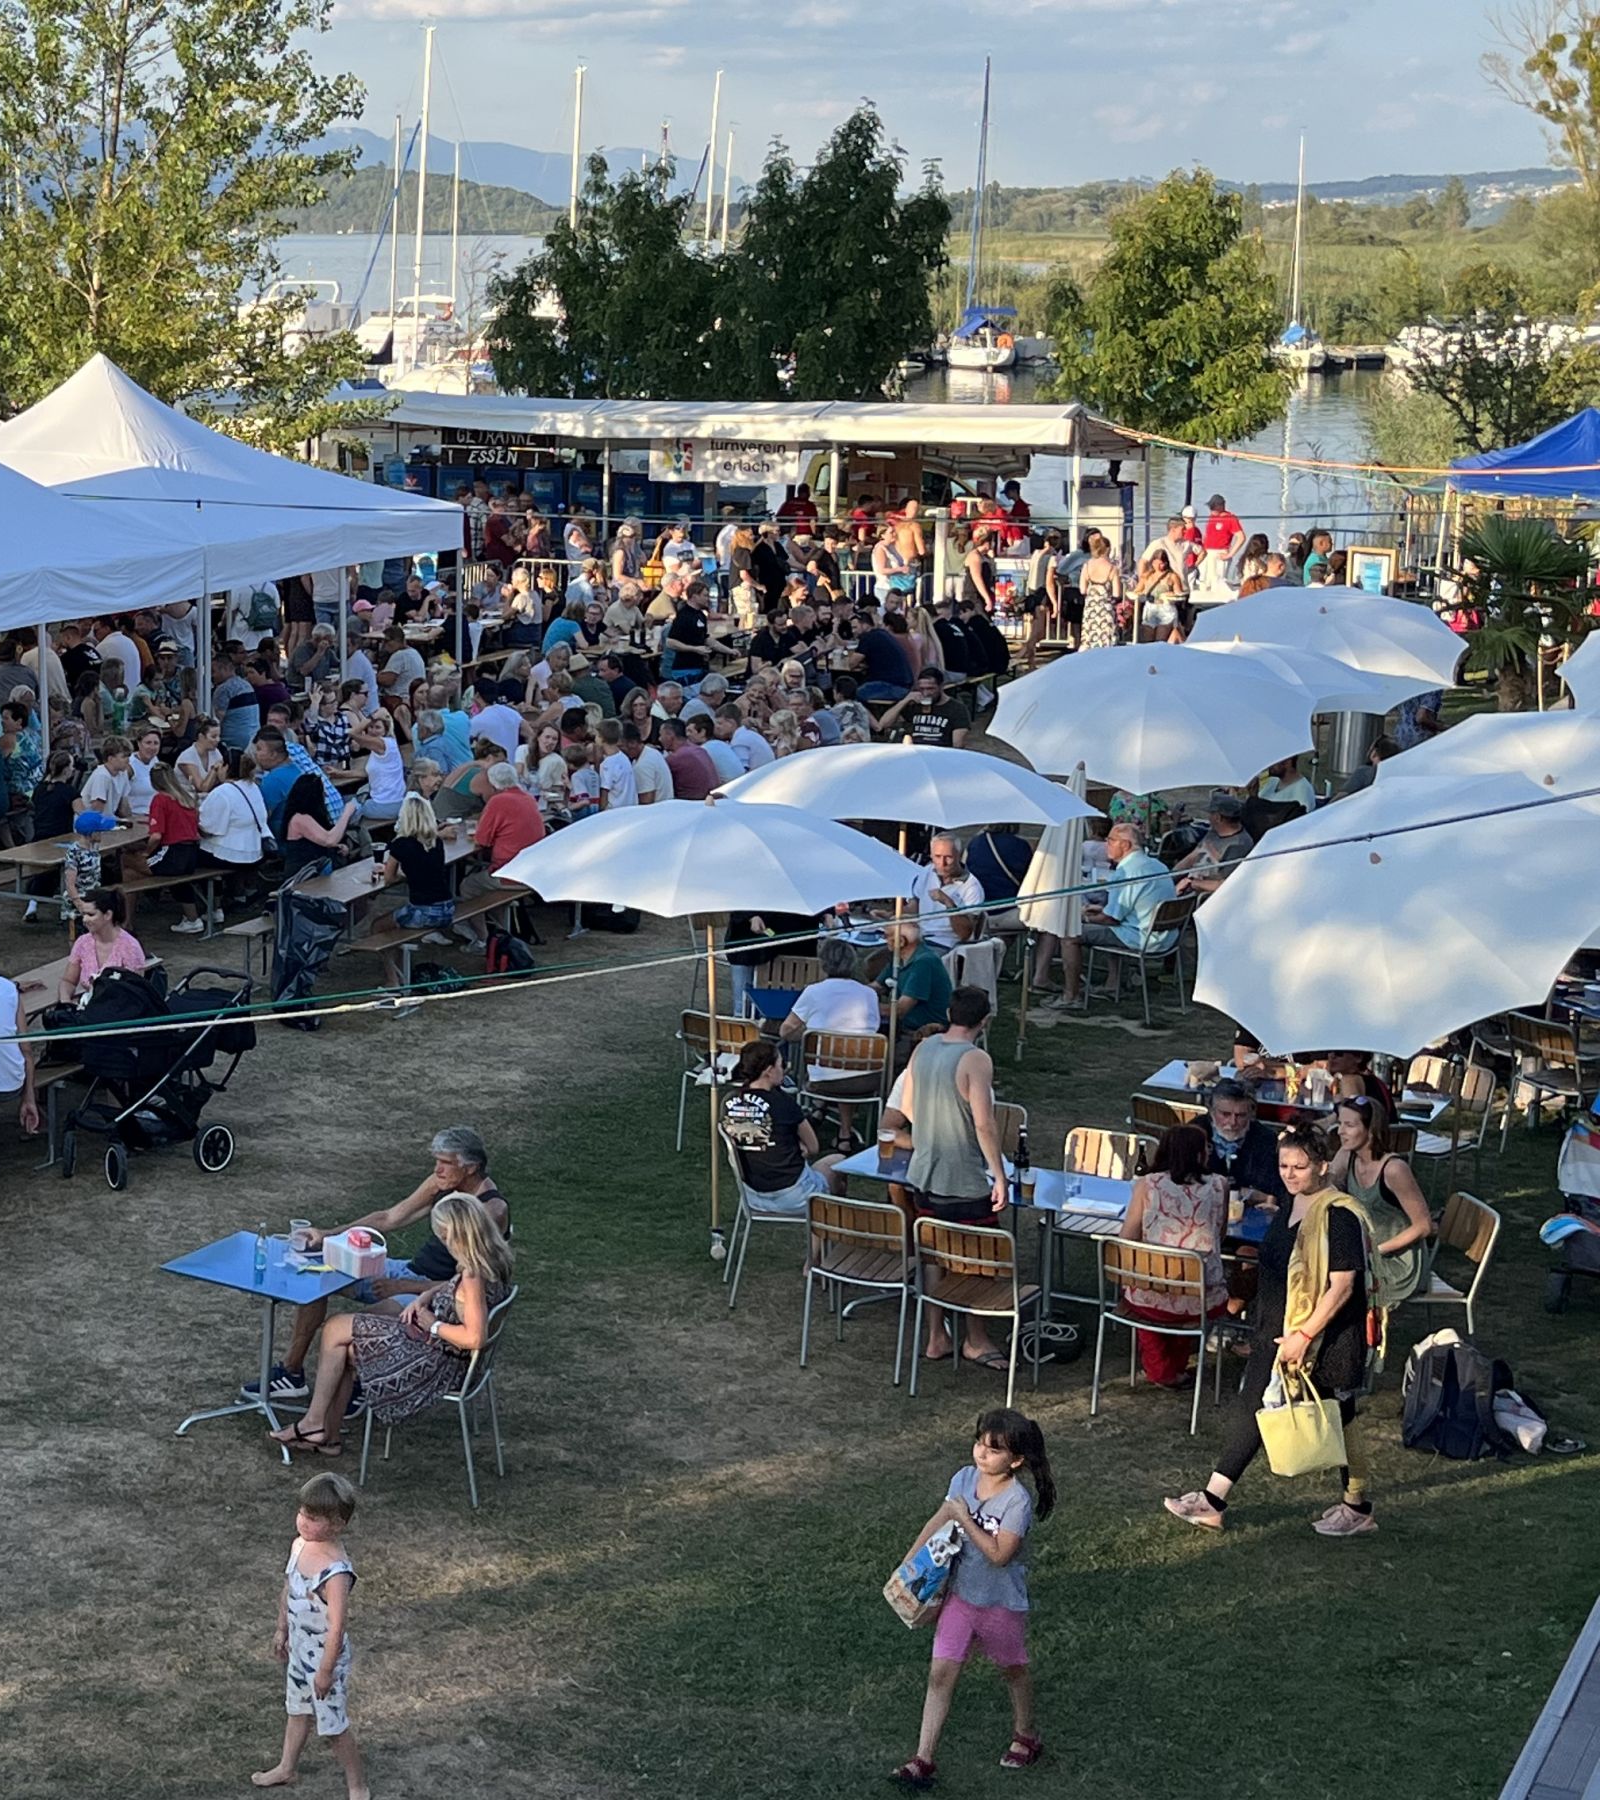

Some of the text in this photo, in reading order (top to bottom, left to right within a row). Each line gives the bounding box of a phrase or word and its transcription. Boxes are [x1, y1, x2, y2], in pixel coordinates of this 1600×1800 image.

[710, 439, 786, 454] turnverein
[467, 449, 518, 466] ESSEN
[723, 459, 770, 474] erlach
